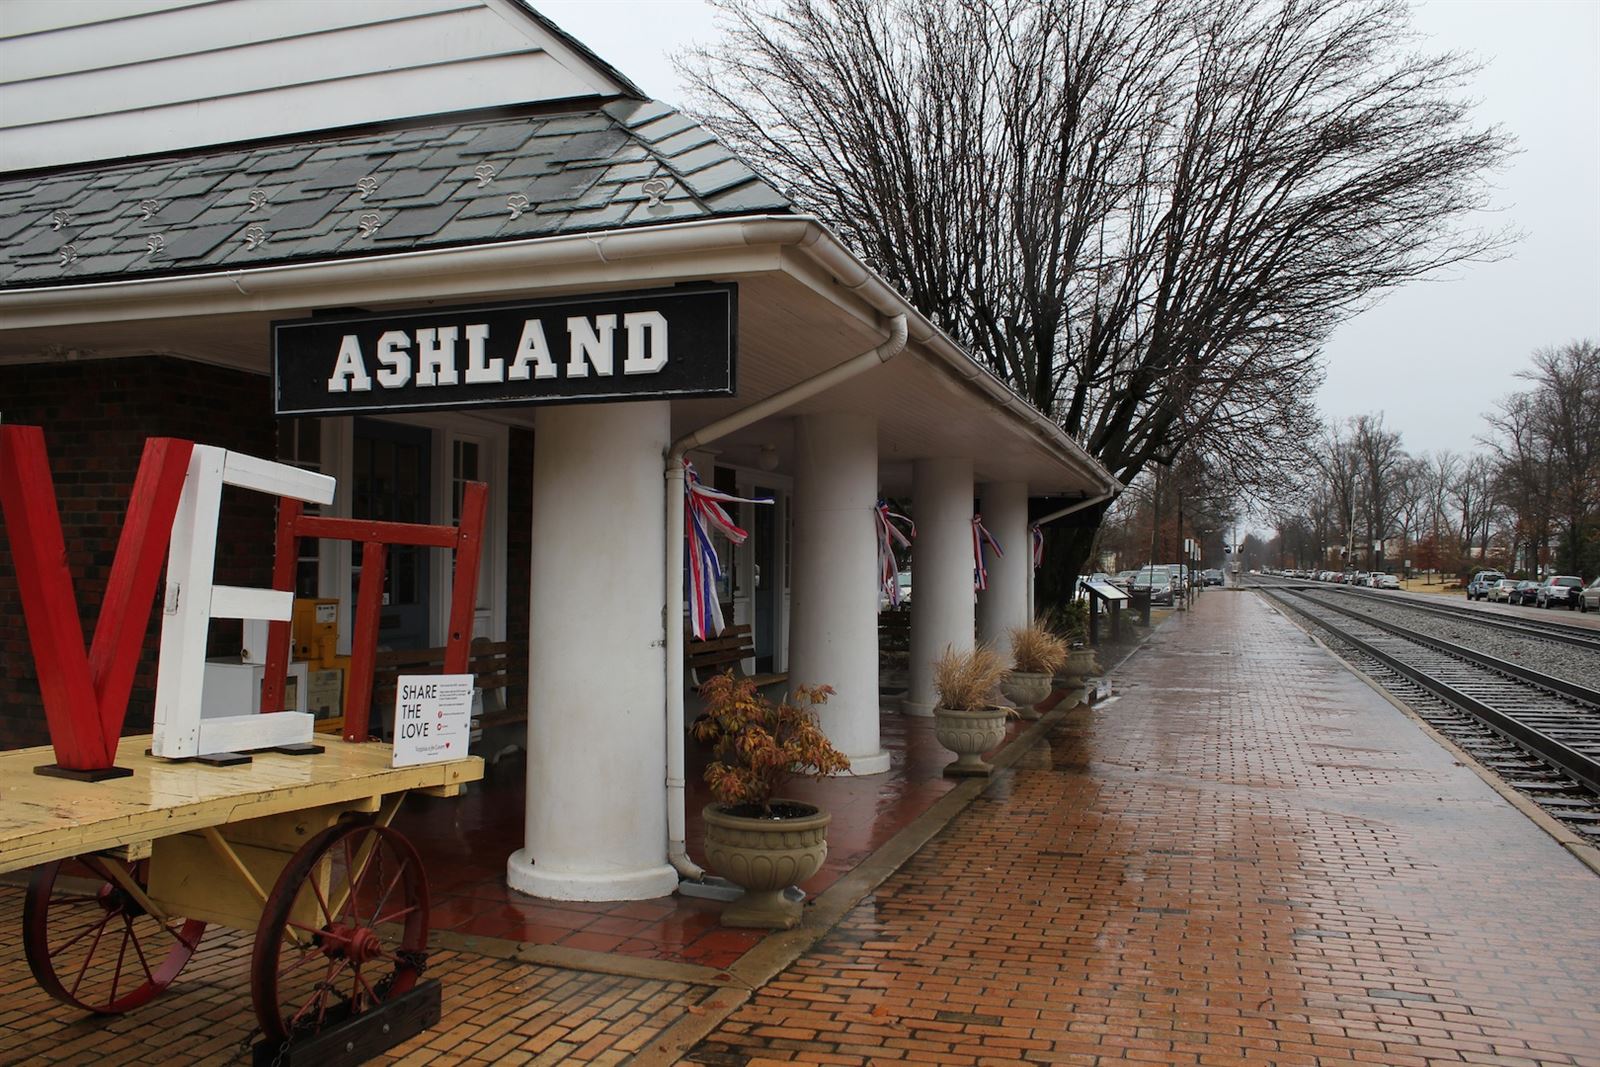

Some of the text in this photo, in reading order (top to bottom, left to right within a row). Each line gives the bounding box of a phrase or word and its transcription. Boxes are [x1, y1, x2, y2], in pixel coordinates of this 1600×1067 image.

[328, 310, 669, 393] ASHLAND
[402, 684, 438, 700] SHARE
[402, 704, 422, 719] THE
[401, 722, 430, 739] LOVE
